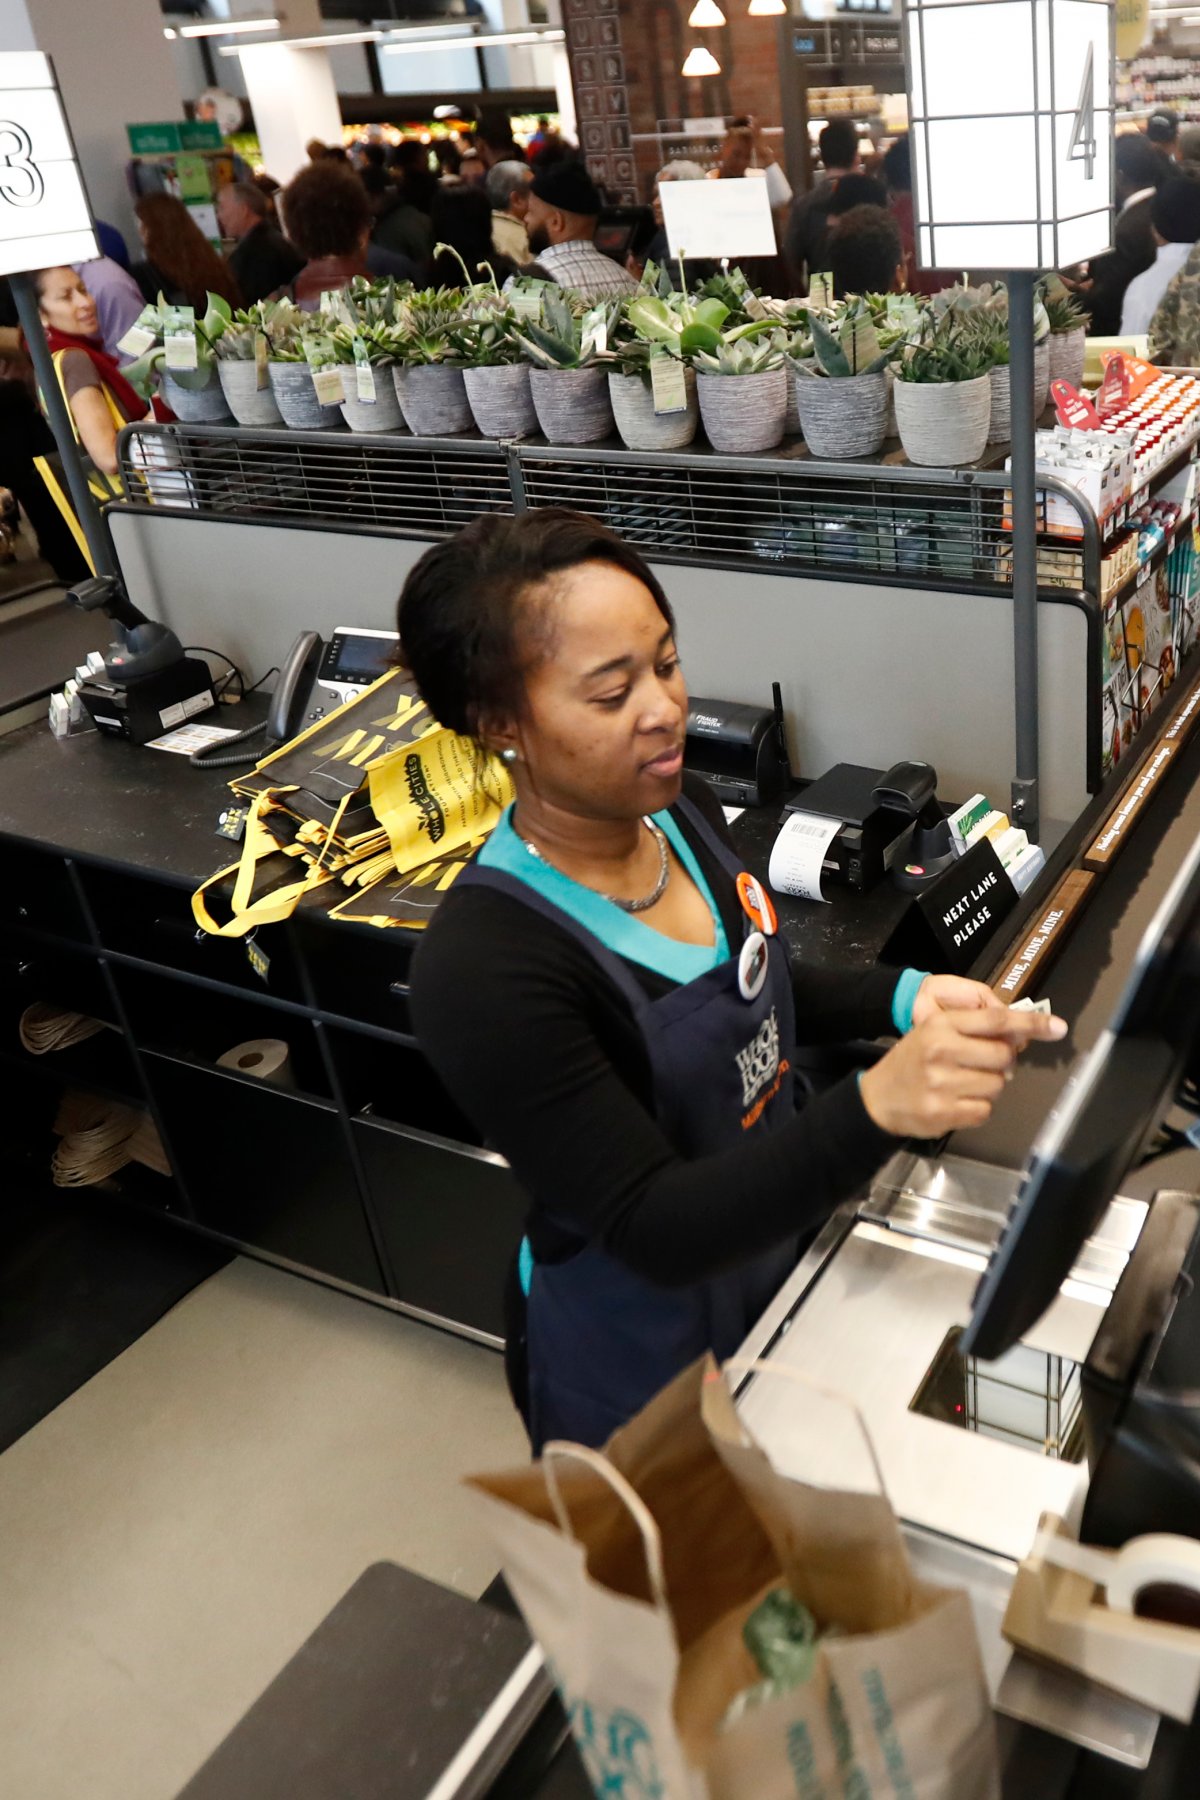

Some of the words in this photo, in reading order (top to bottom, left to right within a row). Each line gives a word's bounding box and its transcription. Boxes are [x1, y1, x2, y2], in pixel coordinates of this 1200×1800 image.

[1066, 40, 1096, 180] 4
[0, 120, 44, 207] 3
[696, 714, 719, 723] FRAUD
[408, 757, 425, 796] CITIES
[420, 795, 441, 840] WHOLE
[943, 896, 971, 927] NEXT
[970, 871, 998, 901] LANE
[953, 906, 992, 947] PLEASE
[1001, 963, 1030, 991] MINE,
[1020, 935, 1049, 962] MINE,
[1038, 910, 1064, 934] MINE.
